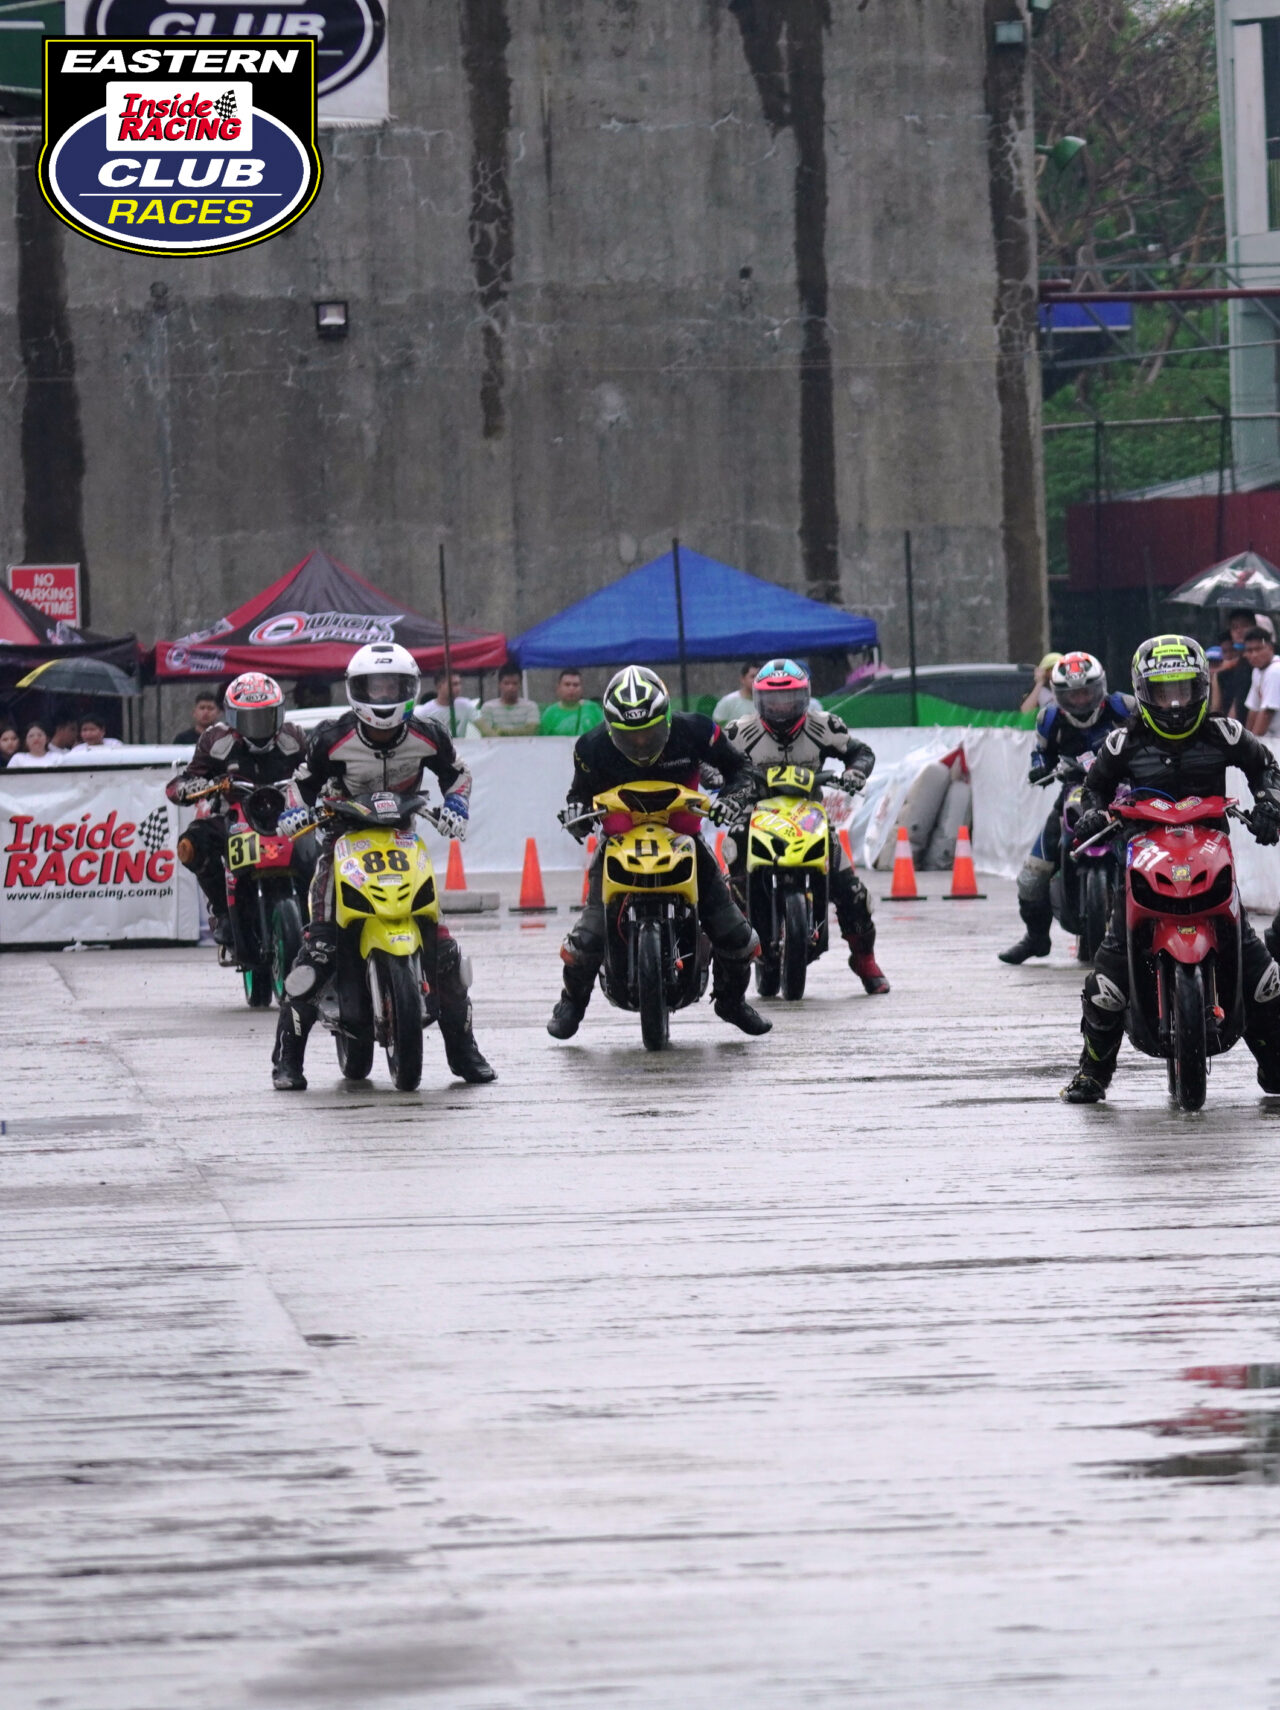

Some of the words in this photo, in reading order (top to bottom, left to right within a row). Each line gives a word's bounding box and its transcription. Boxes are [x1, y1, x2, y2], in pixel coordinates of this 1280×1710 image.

[34, 573, 55, 587] NO
[15, 587, 75, 601] PARKING
[772, 764, 811, 786] 29
[5, 810, 136, 852] Inside
[231, 833, 257, 866] 31
[4, 849, 175, 887] RACING
[362, 850, 410, 873] 88
[6, 887, 174, 901] www.insideracing.com.ph
